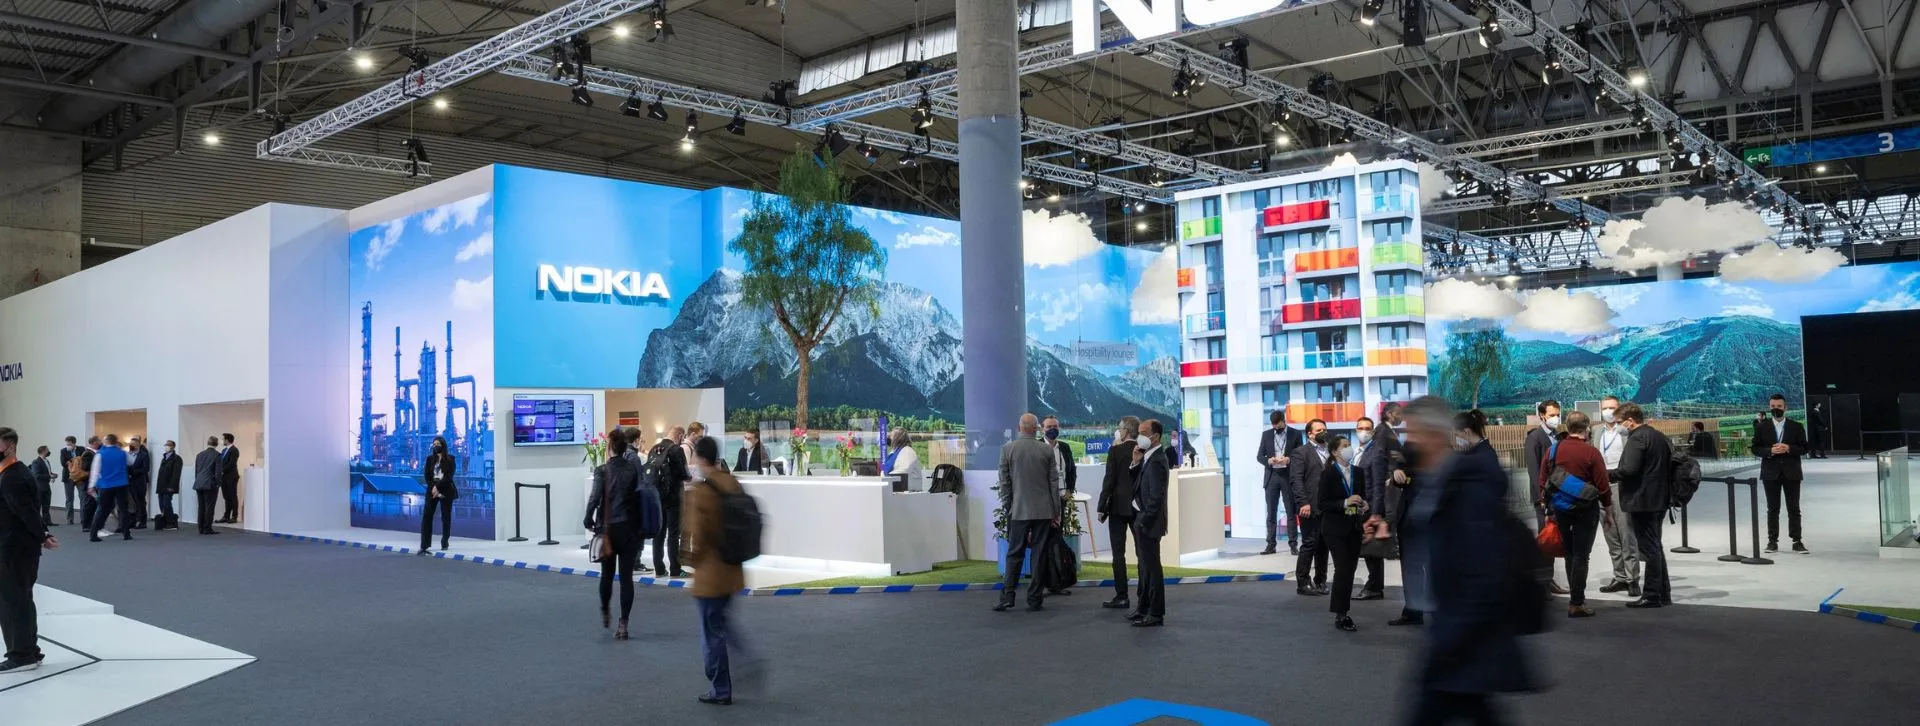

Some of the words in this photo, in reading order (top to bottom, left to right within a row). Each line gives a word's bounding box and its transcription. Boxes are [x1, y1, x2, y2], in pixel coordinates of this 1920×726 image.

[1878, 132, 1895, 153] 3
[537, 263, 671, 300] NOKIA
[1075, 346, 1111, 360] Hospitality
[1112, 347, 1135, 361] lounge
[1087, 442, 1104, 451] ENTRY
